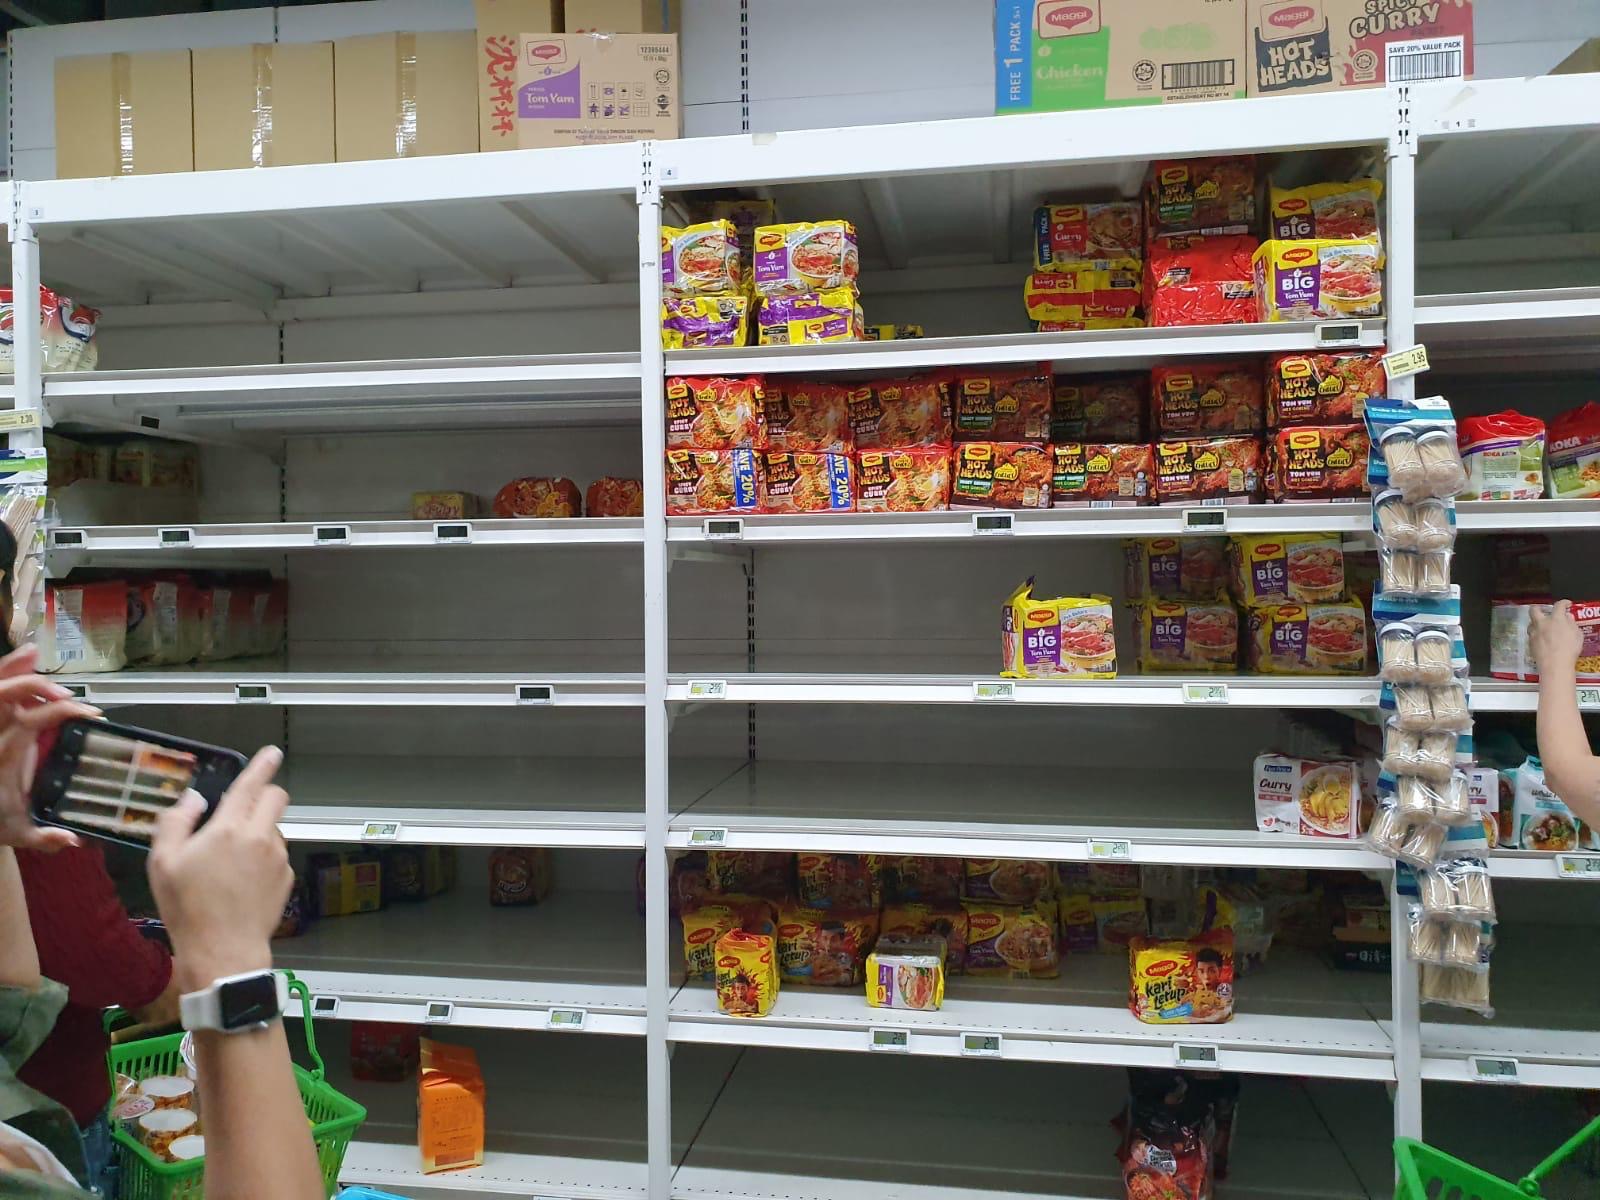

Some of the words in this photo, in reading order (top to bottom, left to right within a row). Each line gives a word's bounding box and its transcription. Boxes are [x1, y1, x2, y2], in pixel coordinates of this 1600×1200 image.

[1051, 11, 1088, 22] Maggi
[1273, 10, 1309, 23] Maggi
[1349, 3, 1440, 39] CURRY
[1010, 22, 1021, 52] PACK
[1267, 38, 1315, 66] HOT
[1003, 58, 1024, 69] 1
[1036, 64, 1104, 80] Chicken
[1260, 56, 1329, 87] HEADS
[1010, 72, 1021, 101] FREE
[525, 92, 549, 104] Tom
[1280, 222, 1311, 238] BIG
[1054, 232, 1082, 242] Curry
[1281, 277, 1315, 291] BIG
[1411, 351, 1426, 364] 2.95
[1285, 377, 1310, 390] HOT
[1280, 387, 1317, 400] HEADS
[670, 399, 689, 410] HOT
[967, 396, 986, 406] HOT
[1165, 400, 1198, 411] HEADS
[668, 407, 696, 418] HEADS
[961, 404, 993, 414] HEADS
[669, 423, 694, 432] CURRY
[739, 449, 751, 471] AVE
[1164, 454, 1186, 466] HOT
[1294, 449, 1319, 460] HOT
[834, 454, 845, 475] AVE
[966, 460, 988, 470] HOT
[1058, 456, 1080, 466] HOT
[1289, 459, 1325, 470] HEADS
[771, 463, 789, 474] HOT
[864, 467, 884, 477] HOT
[960, 467, 993, 479] HEADS
[1053, 464, 1085, 474] HEADS
[1160, 463, 1193, 475] HEADS
[768, 471, 796, 483] HEADS
[860, 474, 891, 485] HEADS
[741, 474, 755, 504] 20%
[770, 486, 794, 495] CURRY
[835, 477, 850, 506] 20%
[863, 489, 888, 498] CURRY
[1152, 562, 1178, 572] BIG
[1256, 567, 1283, 580] BIG
[1155, 624, 1182, 635] BIG
[1275, 629, 1303, 641] BIG
[1027, 635, 1057, 648] BIG
[1259, 778, 1292, 792] Curry
[1148, 962, 1175, 975] Maggi
[1145, 976, 1172, 998] kari
